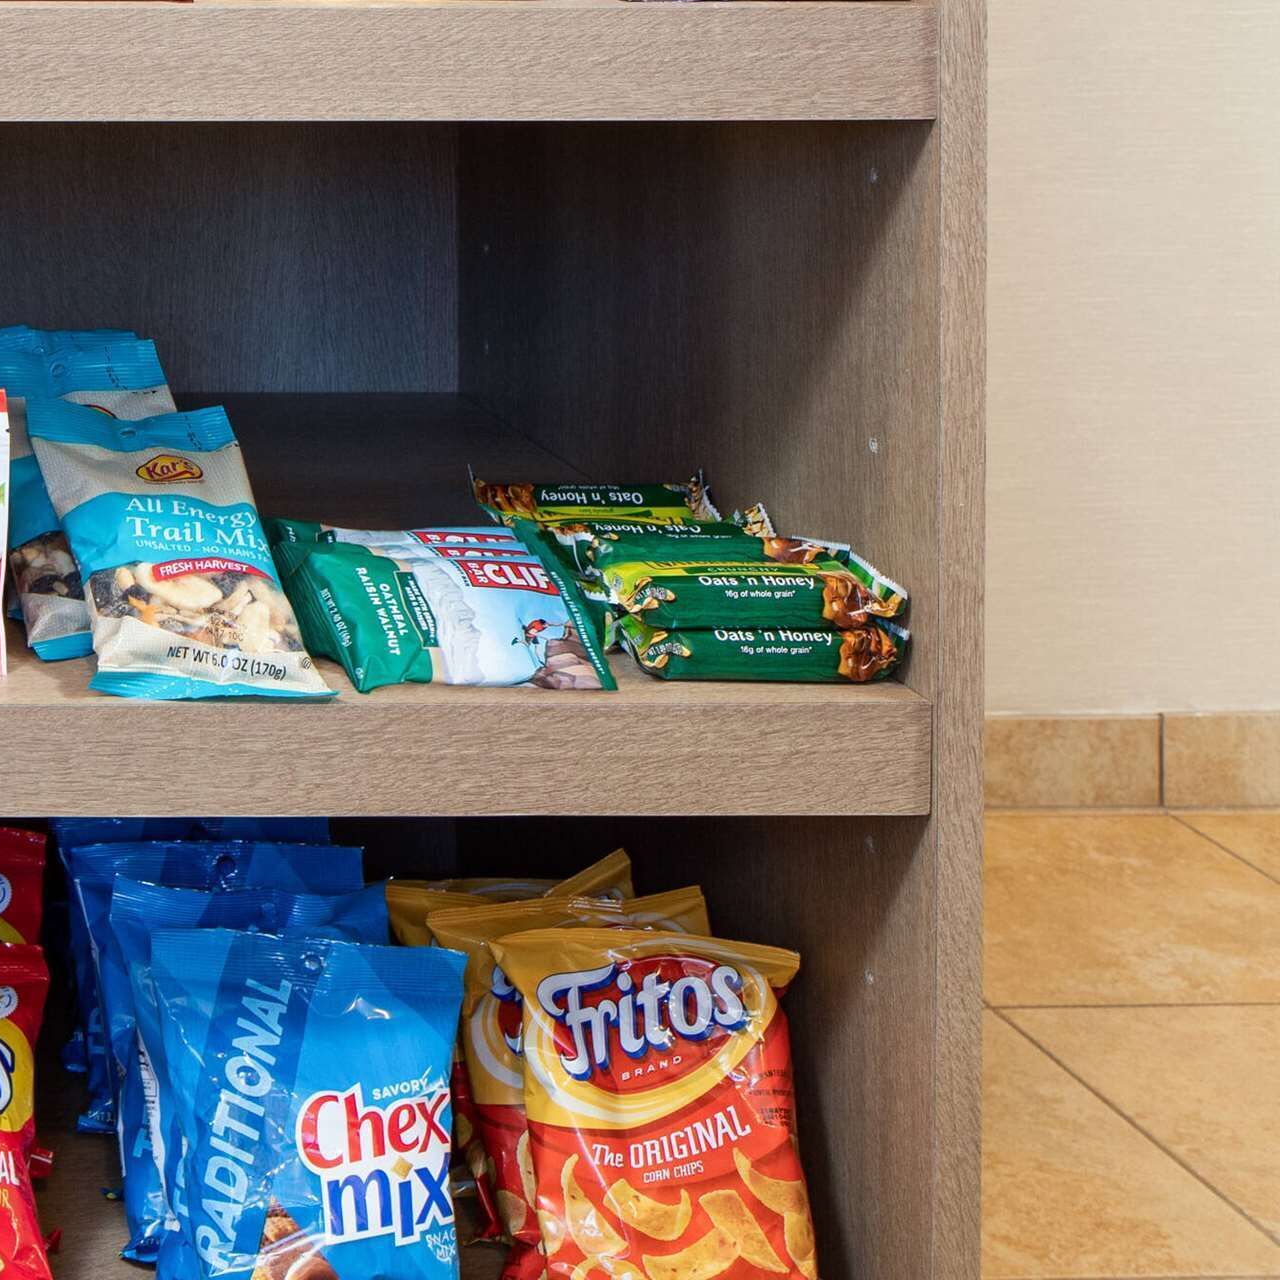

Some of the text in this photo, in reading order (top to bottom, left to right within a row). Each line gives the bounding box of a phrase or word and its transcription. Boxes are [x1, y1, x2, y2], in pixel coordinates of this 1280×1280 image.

[146, 457, 192, 479] Kar's
[125, 497, 257, 528] All Energy
[126, 516, 271, 557] Trail Mix
[160, 559, 250, 577] FRESH HARVEST
[484, 561, 554, 589] CLIF
[698, 575, 816, 590] Oats Honey
[750, 589, 773, 598] whole
[355, 567, 401, 656] RAISIN WALNUT
[379, 583, 409, 636] OATMEAL
[713, 630, 834, 647] Oats Honey
[766, 645, 789, 654] whole
[167, 646, 288, 681] NET WT OZ (170g)
[536, 965, 747, 1082] Fritos
[621, 1055, 684, 1081] BRAND
[372, 1077, 429, 1101] SAVORY
[195, 978, 294, 1277] RADITIONAL
[300, 1090, 450, 1170] Chex
[591, 1105, 753, 1170] The ORIGINAL
[643, 1160, 705, 1185] CORN CHIPS
[326, 1153, 453, 1238] mix
